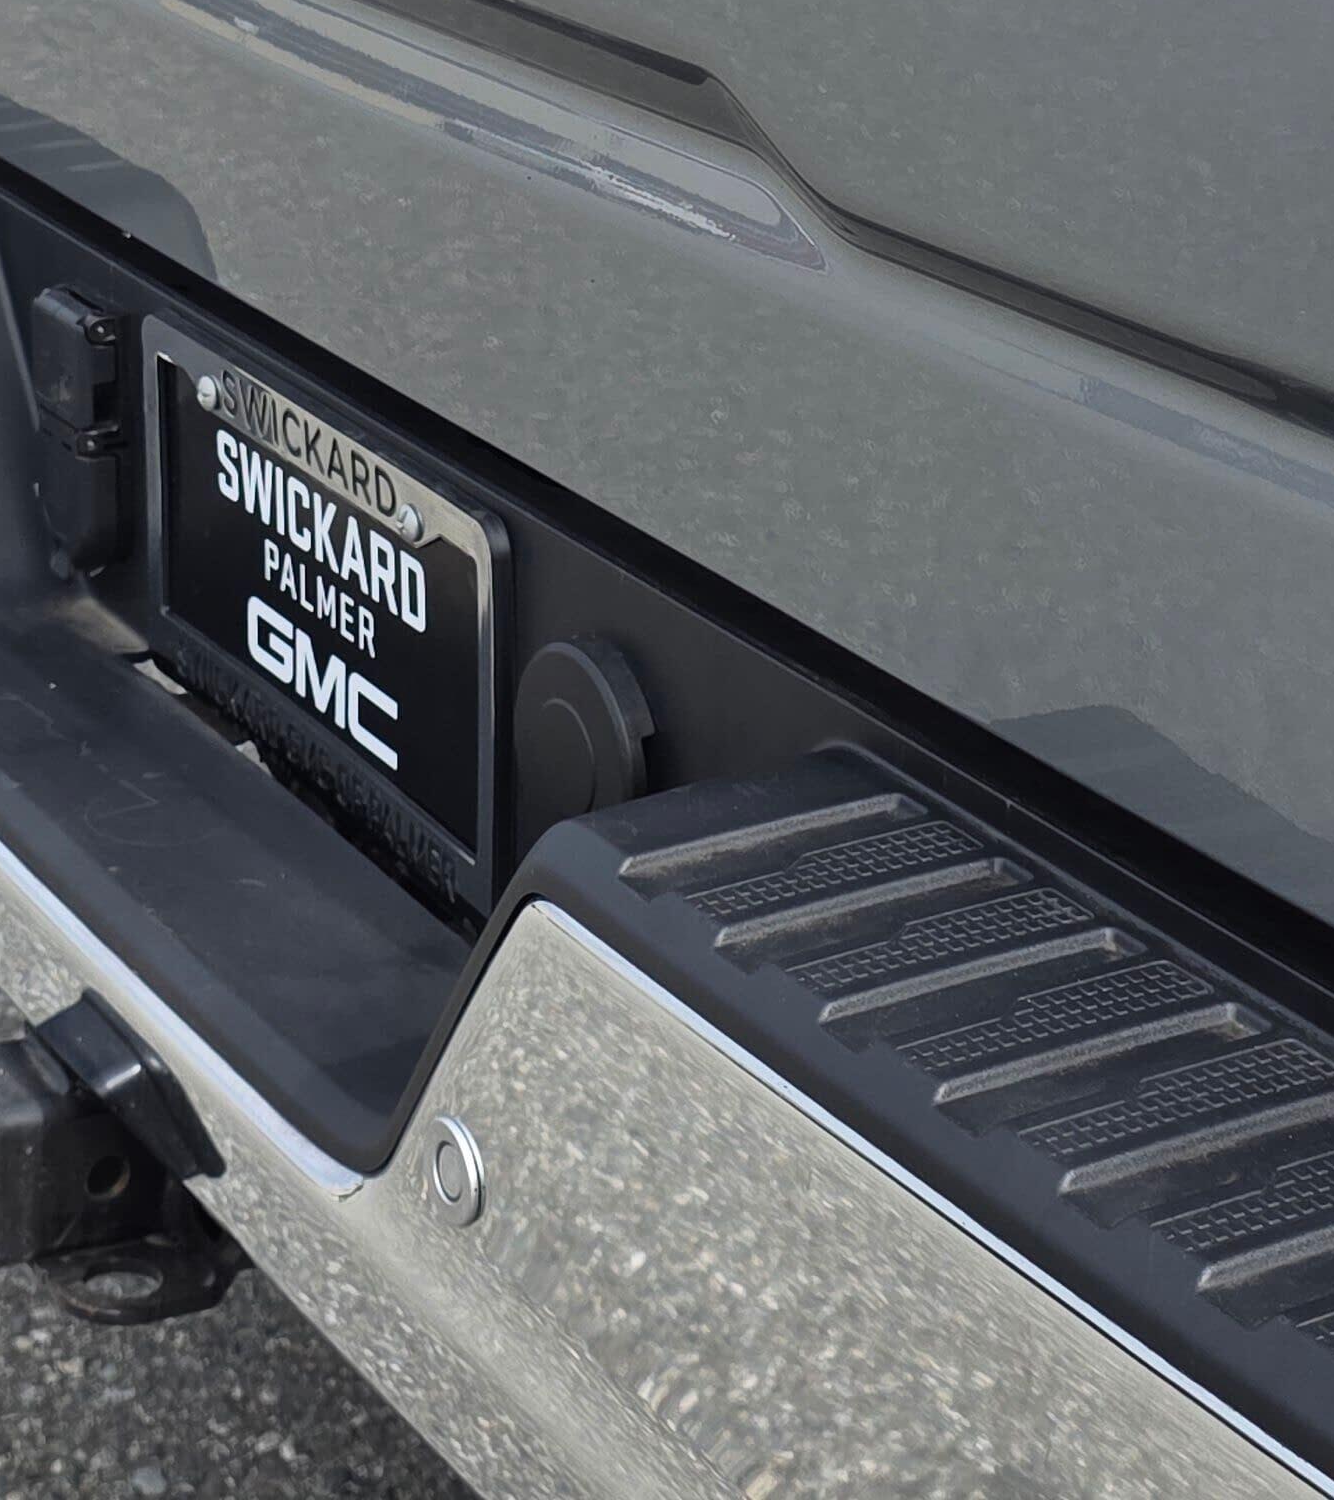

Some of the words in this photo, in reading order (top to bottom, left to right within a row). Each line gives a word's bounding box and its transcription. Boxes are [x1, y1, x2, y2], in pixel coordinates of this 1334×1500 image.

[220, 369, 398, 518] SWICKARD
[216, 429, 427, 634] SWICKARD
[263, 538, 377, 659] PALMER
[247, 595, 399, 771] GMC
